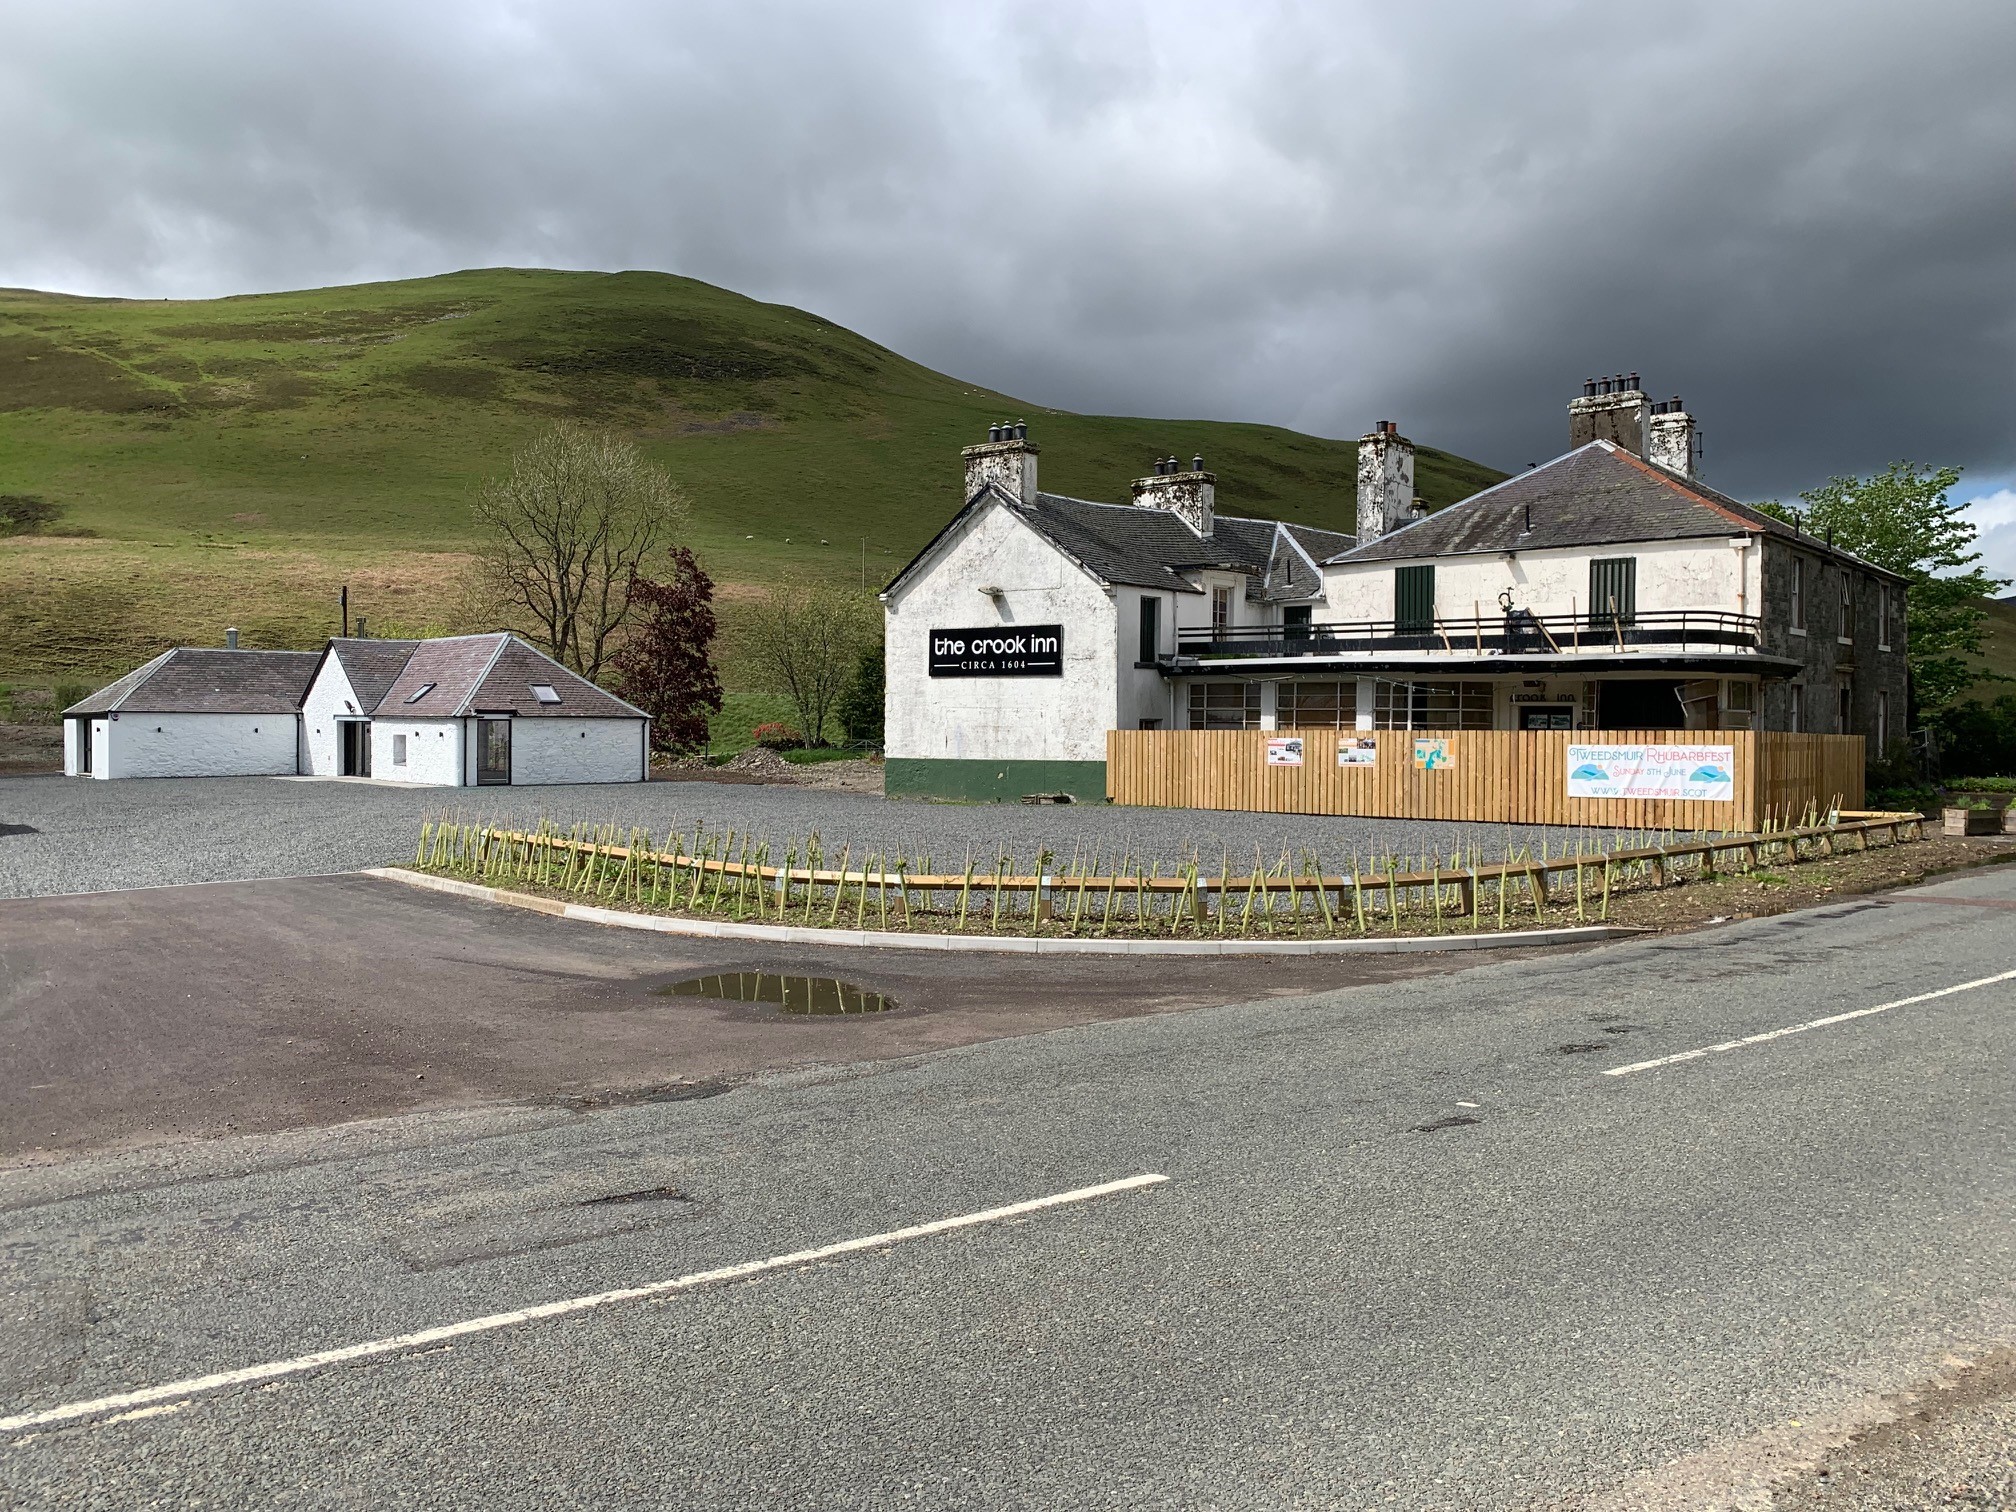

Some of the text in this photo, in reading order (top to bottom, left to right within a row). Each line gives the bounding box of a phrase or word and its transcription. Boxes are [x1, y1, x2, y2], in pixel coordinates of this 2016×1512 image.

[934, 634, 1057, 655] the crook inn
[961, 660, 1026, 669] CIRCA 1604
[1569, 747, 1731, 763] TWEEDSMUIR RHUBARBFEST
[1613, 765, 1645, 777] SUNDAY
[1664, 767, 1686, 778] JUNE
